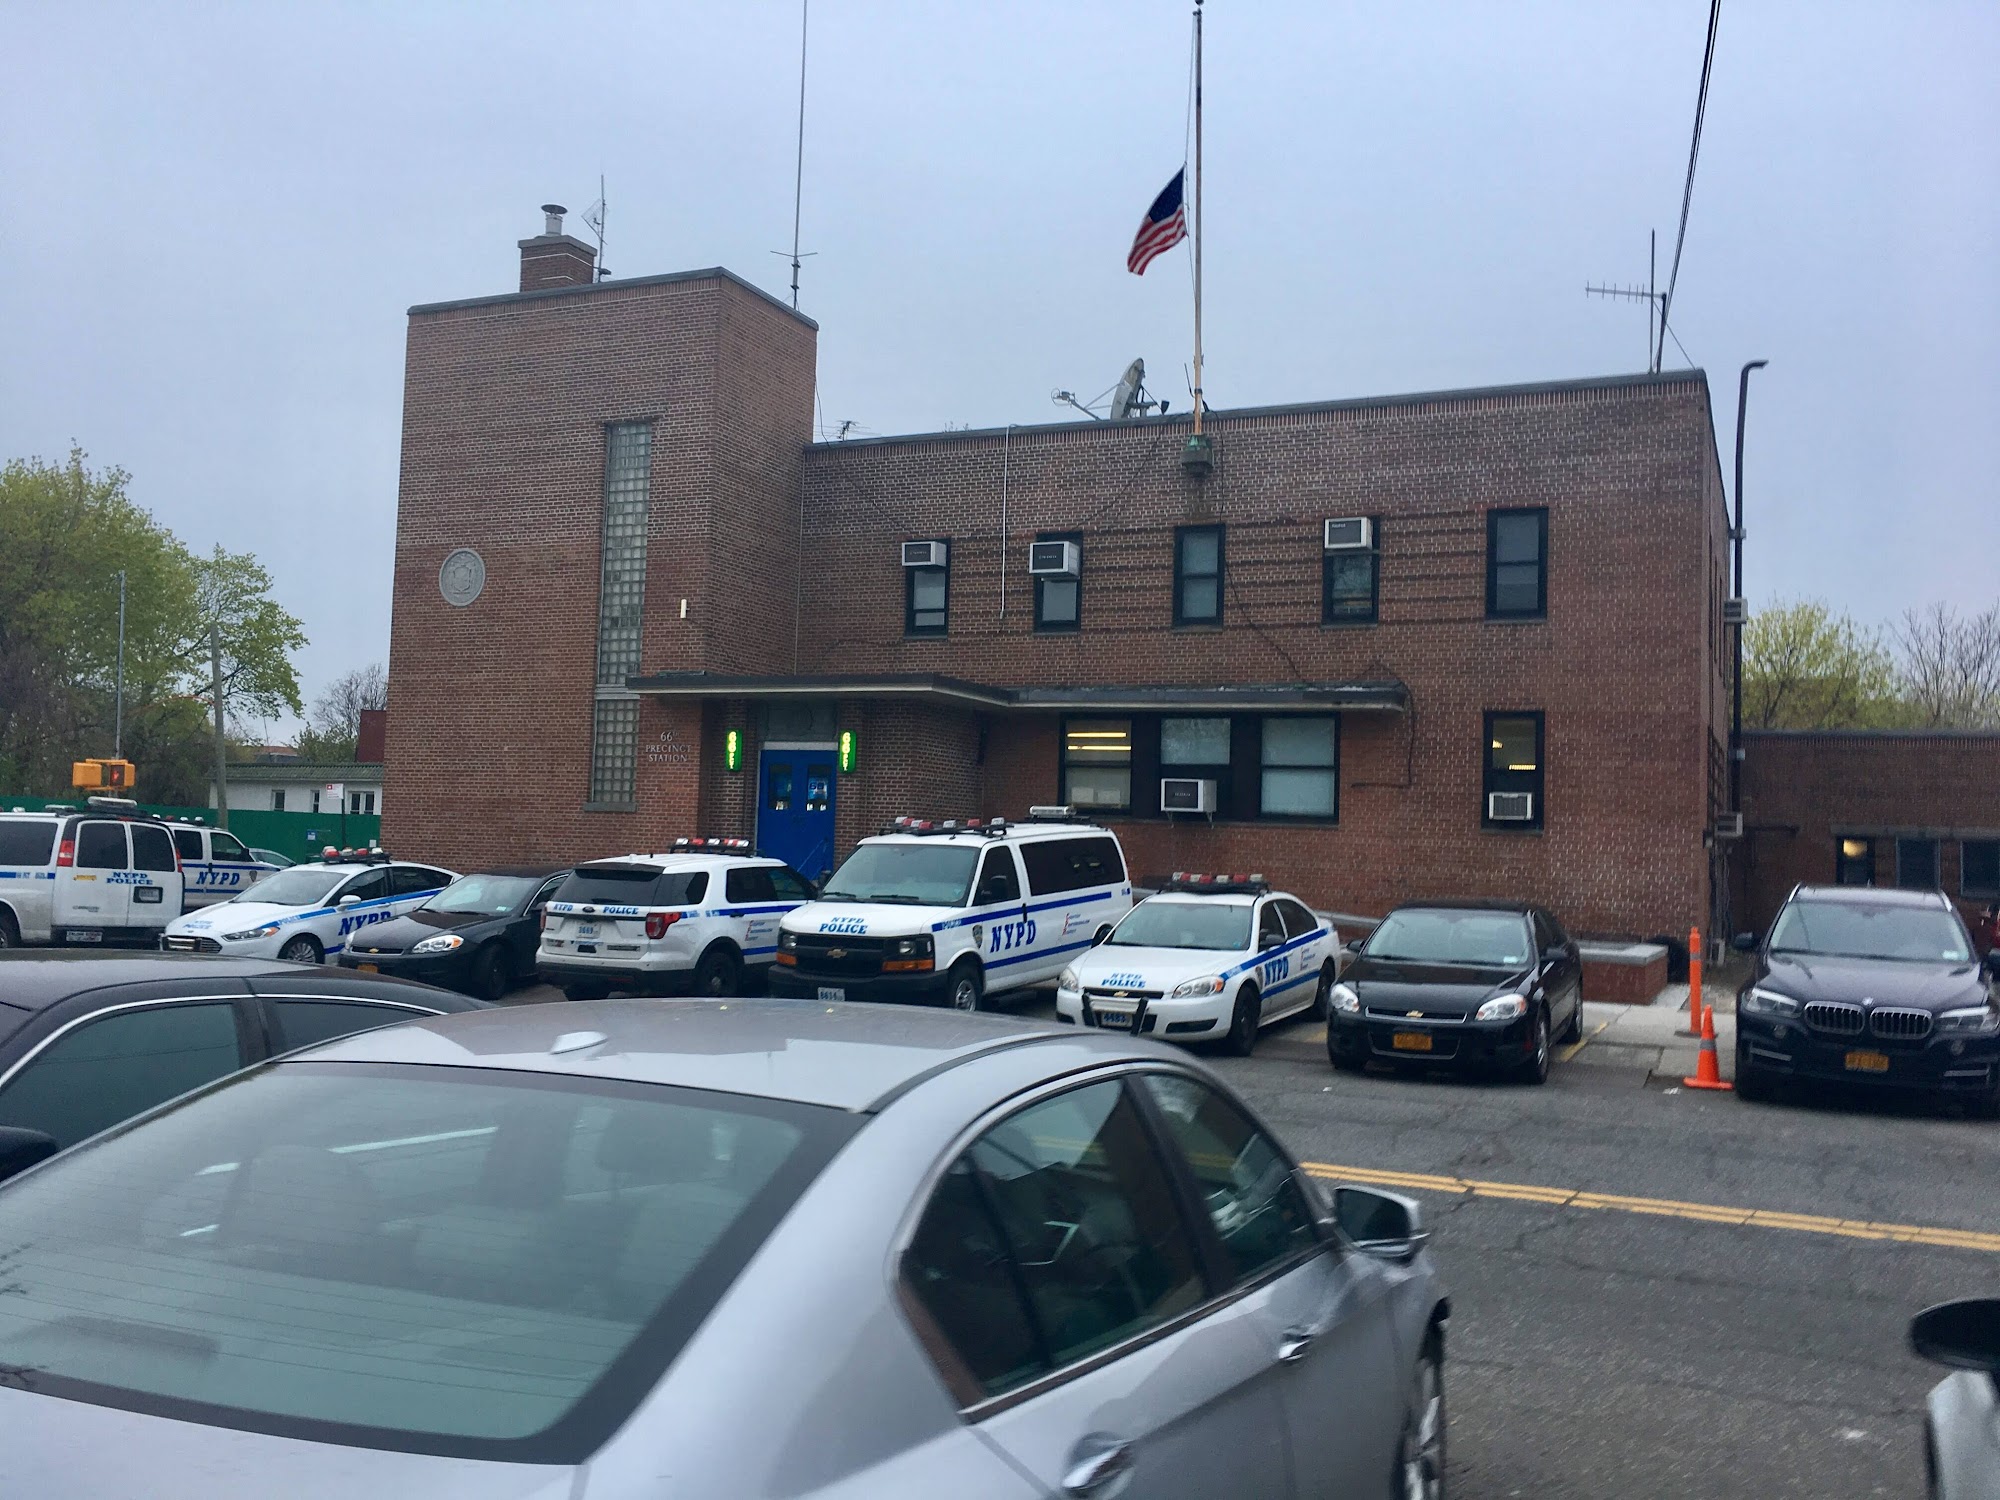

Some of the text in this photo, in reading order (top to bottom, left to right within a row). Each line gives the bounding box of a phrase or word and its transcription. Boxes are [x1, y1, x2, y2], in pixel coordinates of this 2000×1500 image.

[645, 744, 692, 753] PRECINCT
[648, 754, 688, 762] STATION
[196, 871, 240, 886] NYPD
[554, 904, 573, 912] NYPD
[603, 906, 639, 915] POLICE
[278, 914, 301, 926] POLICE
[819, 923, 868, 935] POLICE
[990, 919, 1036, 953] NYPD
[1264, 956, 1289, 987] NYPD
[1101, 979, 1146, 988] POLICE
